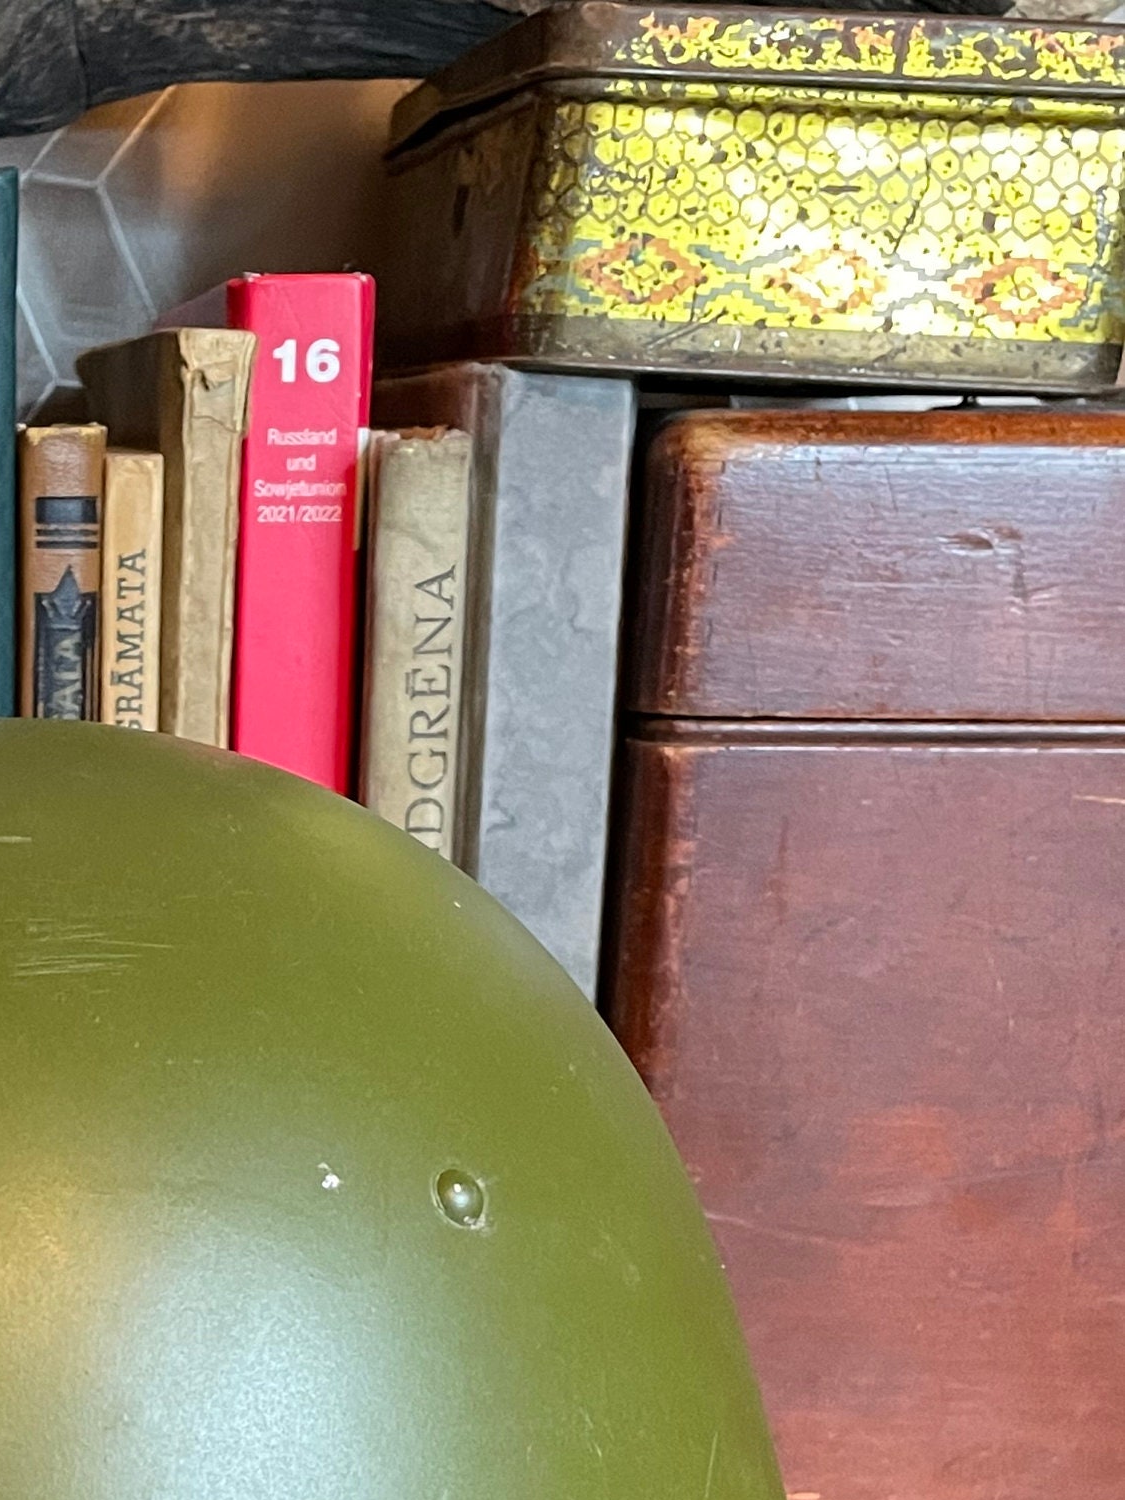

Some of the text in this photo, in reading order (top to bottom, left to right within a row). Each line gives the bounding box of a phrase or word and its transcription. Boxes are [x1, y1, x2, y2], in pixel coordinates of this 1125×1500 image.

[273, 338, 341, 384] 16
[267, 428, 338, 445] Russland
[286, 455, 317, 471] und
[253, 480, 347, 501] Sowjetunion
[257, 505, 343, 523] 2021/2022
[404, 564, 456, 853] DGRĒNA
